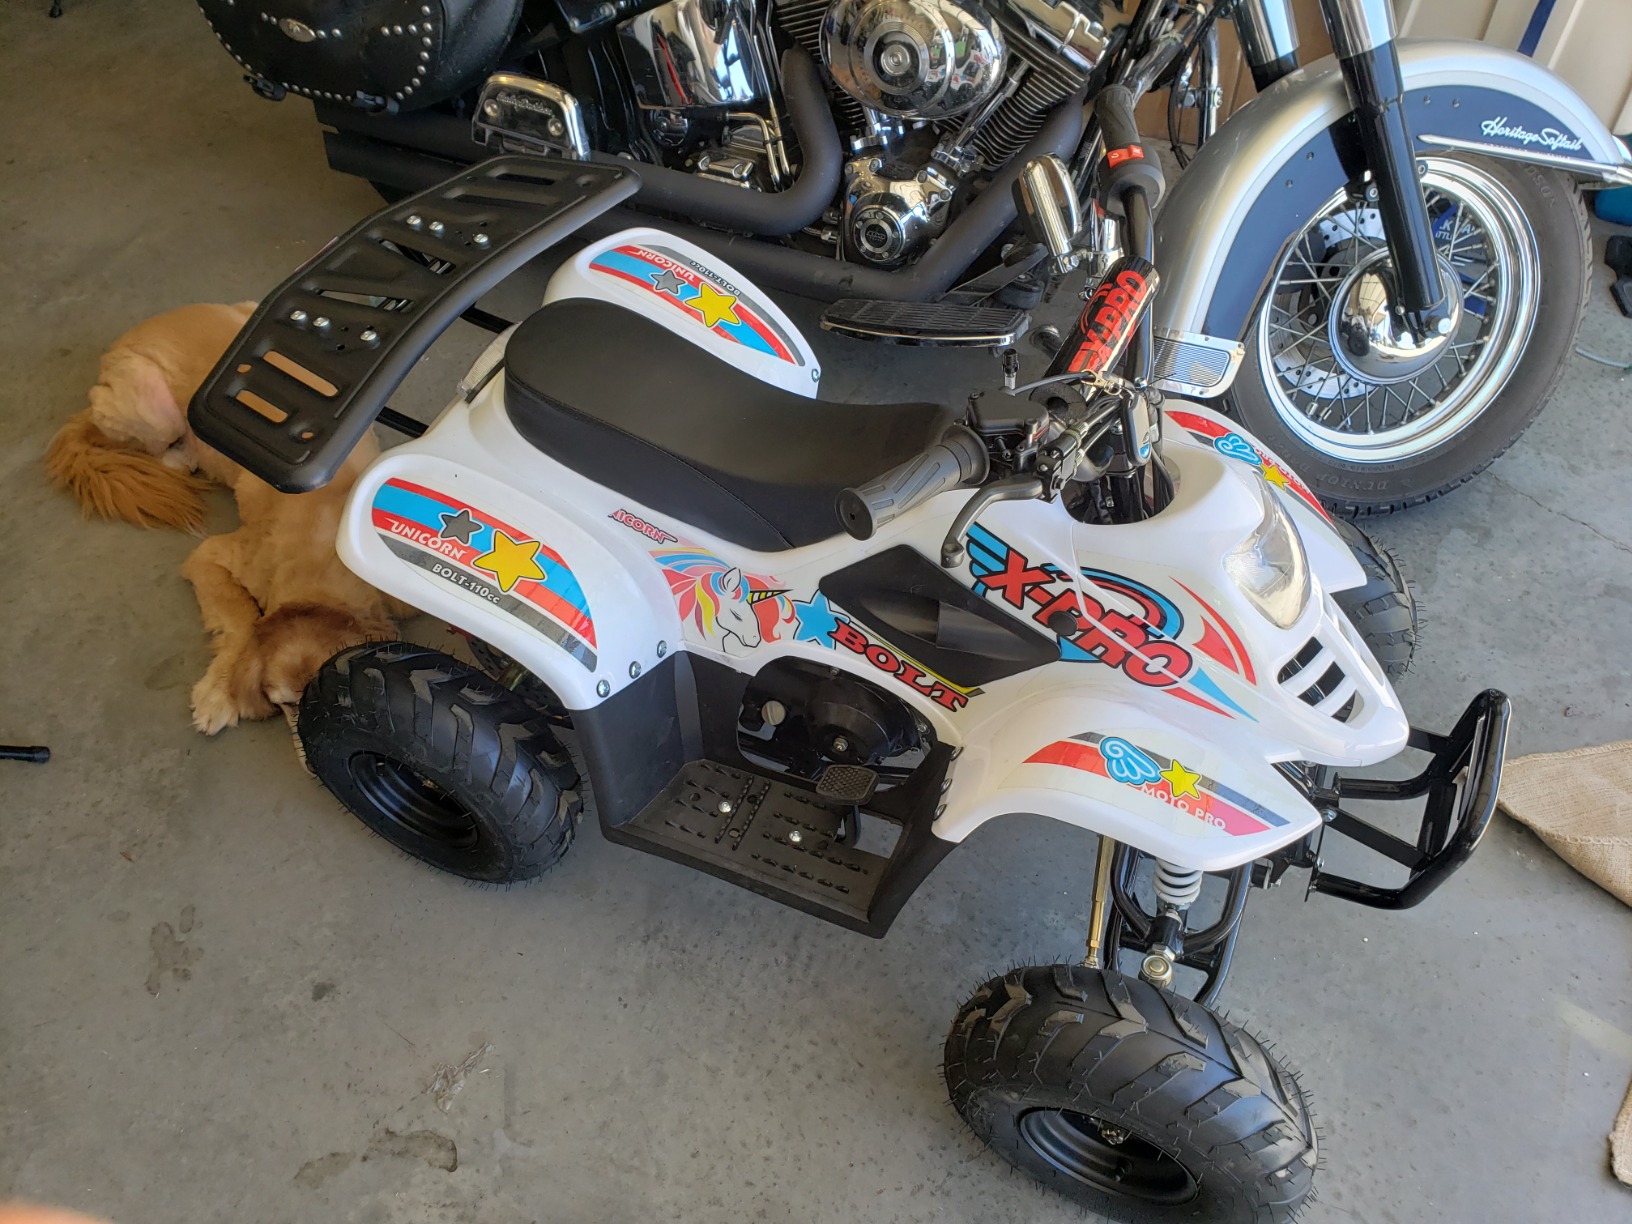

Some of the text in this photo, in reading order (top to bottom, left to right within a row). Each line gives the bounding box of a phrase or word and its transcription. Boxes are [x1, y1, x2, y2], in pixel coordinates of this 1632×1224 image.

[1481, 116, 1582, 151] Heritage Softail
[627, 249, 696, 283] UNICORN
[690, 260, 741, 297] BOLT-110cc
[384, 516, 468, 561] UNICORN
[432, 562, 501, 605] BOLT-110cc
[977, 548, 1193, 688] X-PRO
[827, 616, 969, 713] BOLT
[1140, 784, 1227, 831] MOTO PRO
